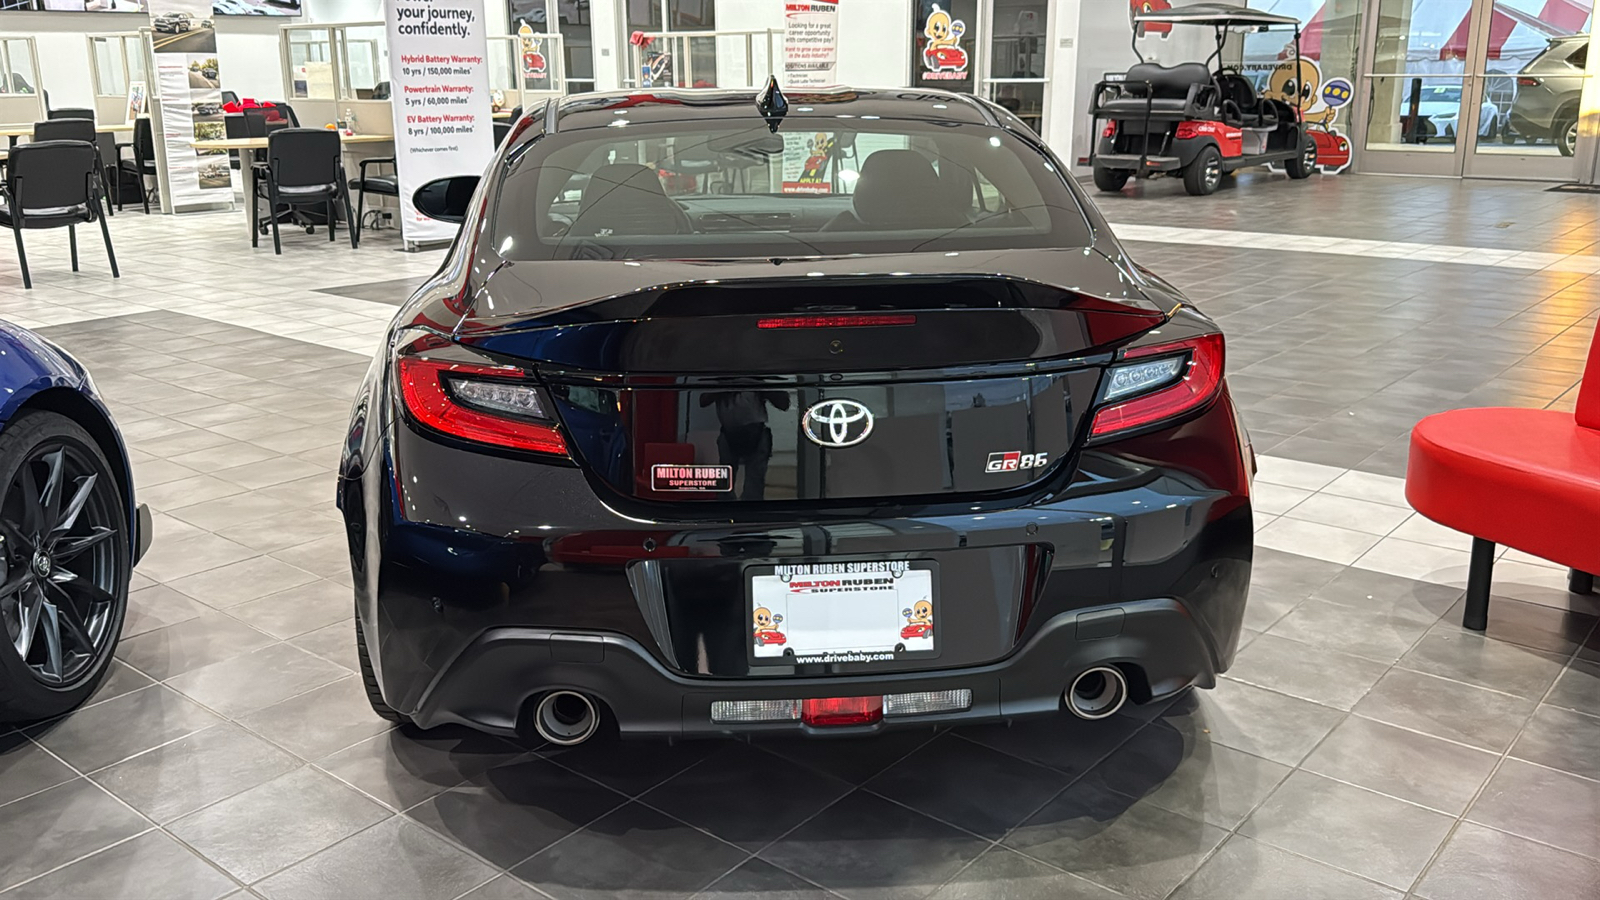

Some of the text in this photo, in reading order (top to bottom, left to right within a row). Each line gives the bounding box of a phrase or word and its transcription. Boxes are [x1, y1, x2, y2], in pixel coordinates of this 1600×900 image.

[396, 5, 475, 23] your journey,
[398, 21, 470, 38] confidently.
[401, 55, 483, 64] Hybrid Battery Warranty:
[427, 67, 452, 76] 150,000
[404, 85, 474, 94] Powertrain Warranty:
[411, 99, 421, 107] yrs
[427, 97, 449, 106] 60,000
[417, 115, 442, 124] Battery
[443, 114, 475, 123] Warranty:
[430, 126, 454, 135] 100,000
[656, 468, 728, 479] MILTON RUBEN
[774, 561, 910, 576] MILTON RUBEN SUPERSTORE
[789, 578, 894, 588] MILTON RUBEN
[796, 653, 894, 663] www.drivebaby.com
